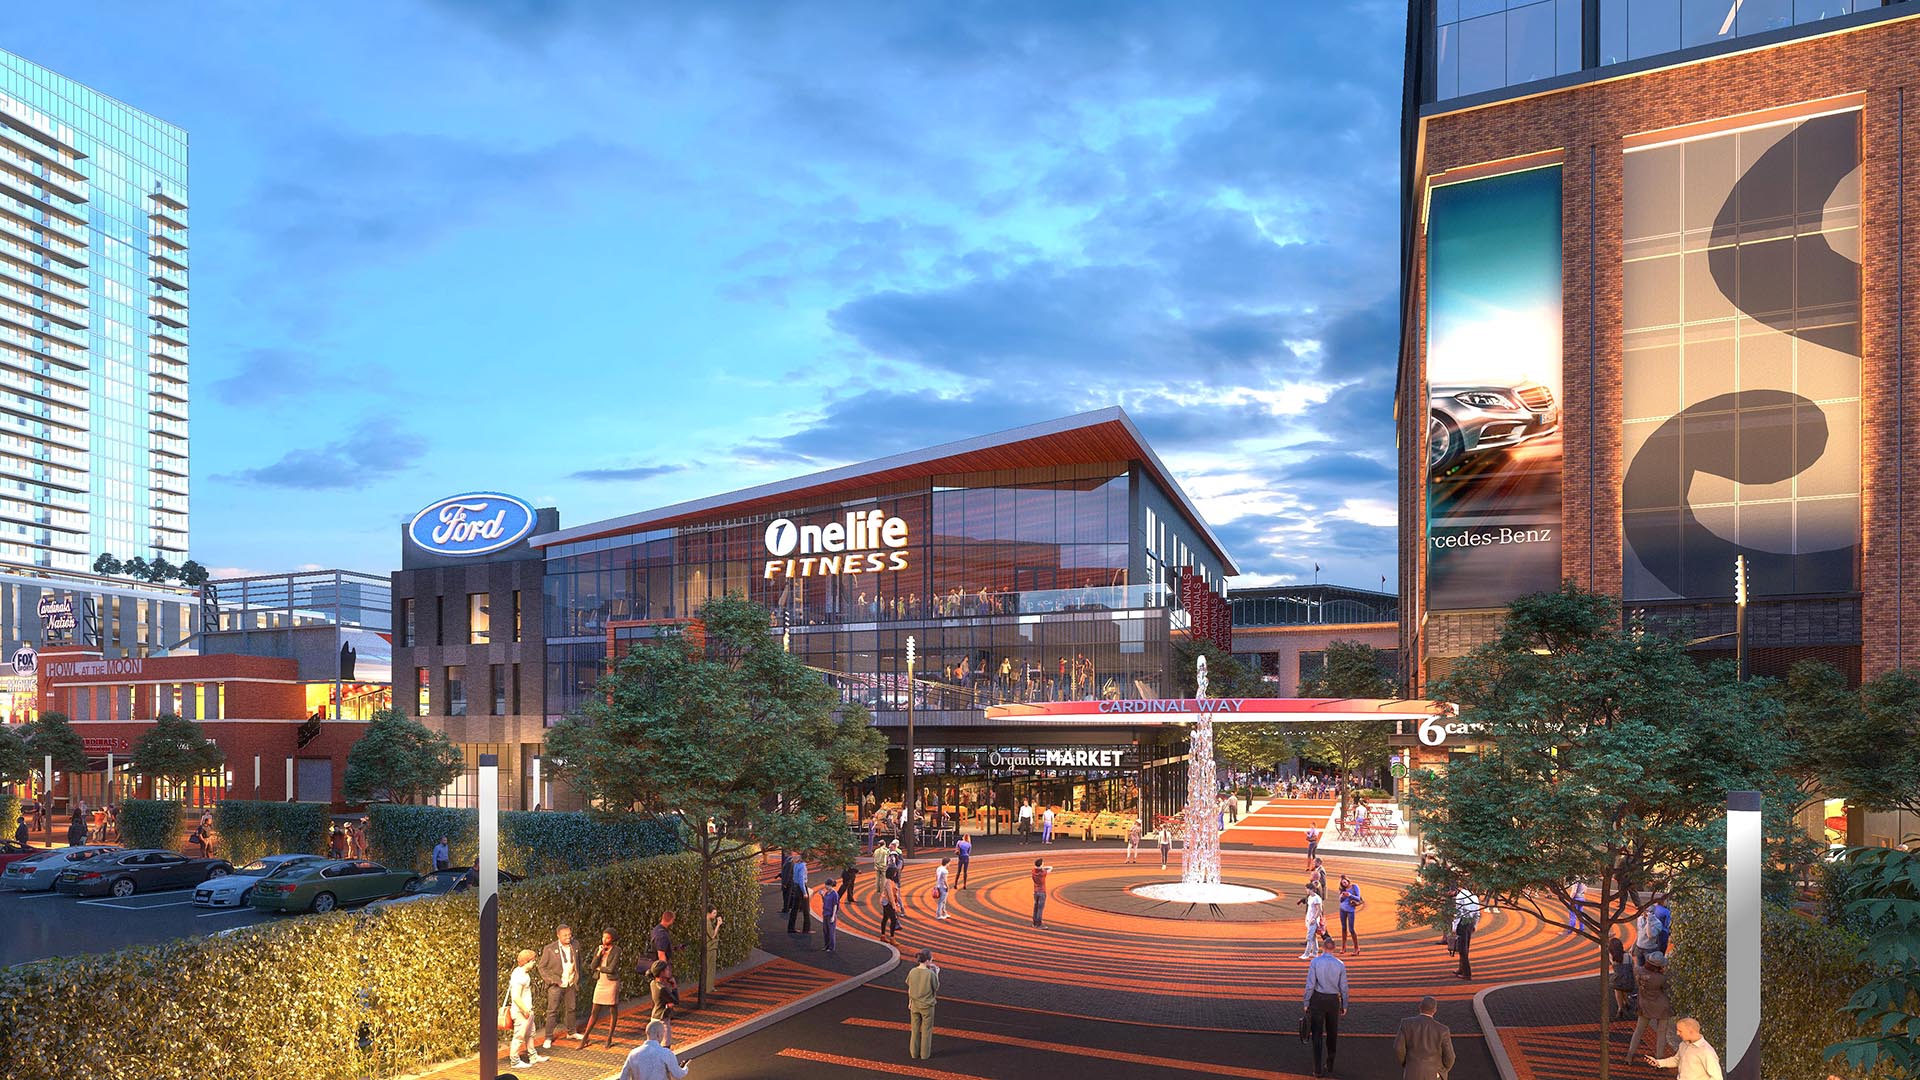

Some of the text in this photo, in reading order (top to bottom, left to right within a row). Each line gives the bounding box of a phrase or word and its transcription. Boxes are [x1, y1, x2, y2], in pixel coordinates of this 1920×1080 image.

[432, 503, 506, 544] Ford
[764, 551, 909, 579] FITNESS
[37, 598, 71, 618] Cardinals
[1193, 582, 1201, 635] CARDINALS
[47, 615, 76, 629] Nation
[17, 653, 34, 666] FOX
[49, 659, 141, 676] HOWL AT THE MOON
[1098, 699, 1244, 713] CARDINAL WAY
[989, 750, 1124, 770] Organic MARKET
